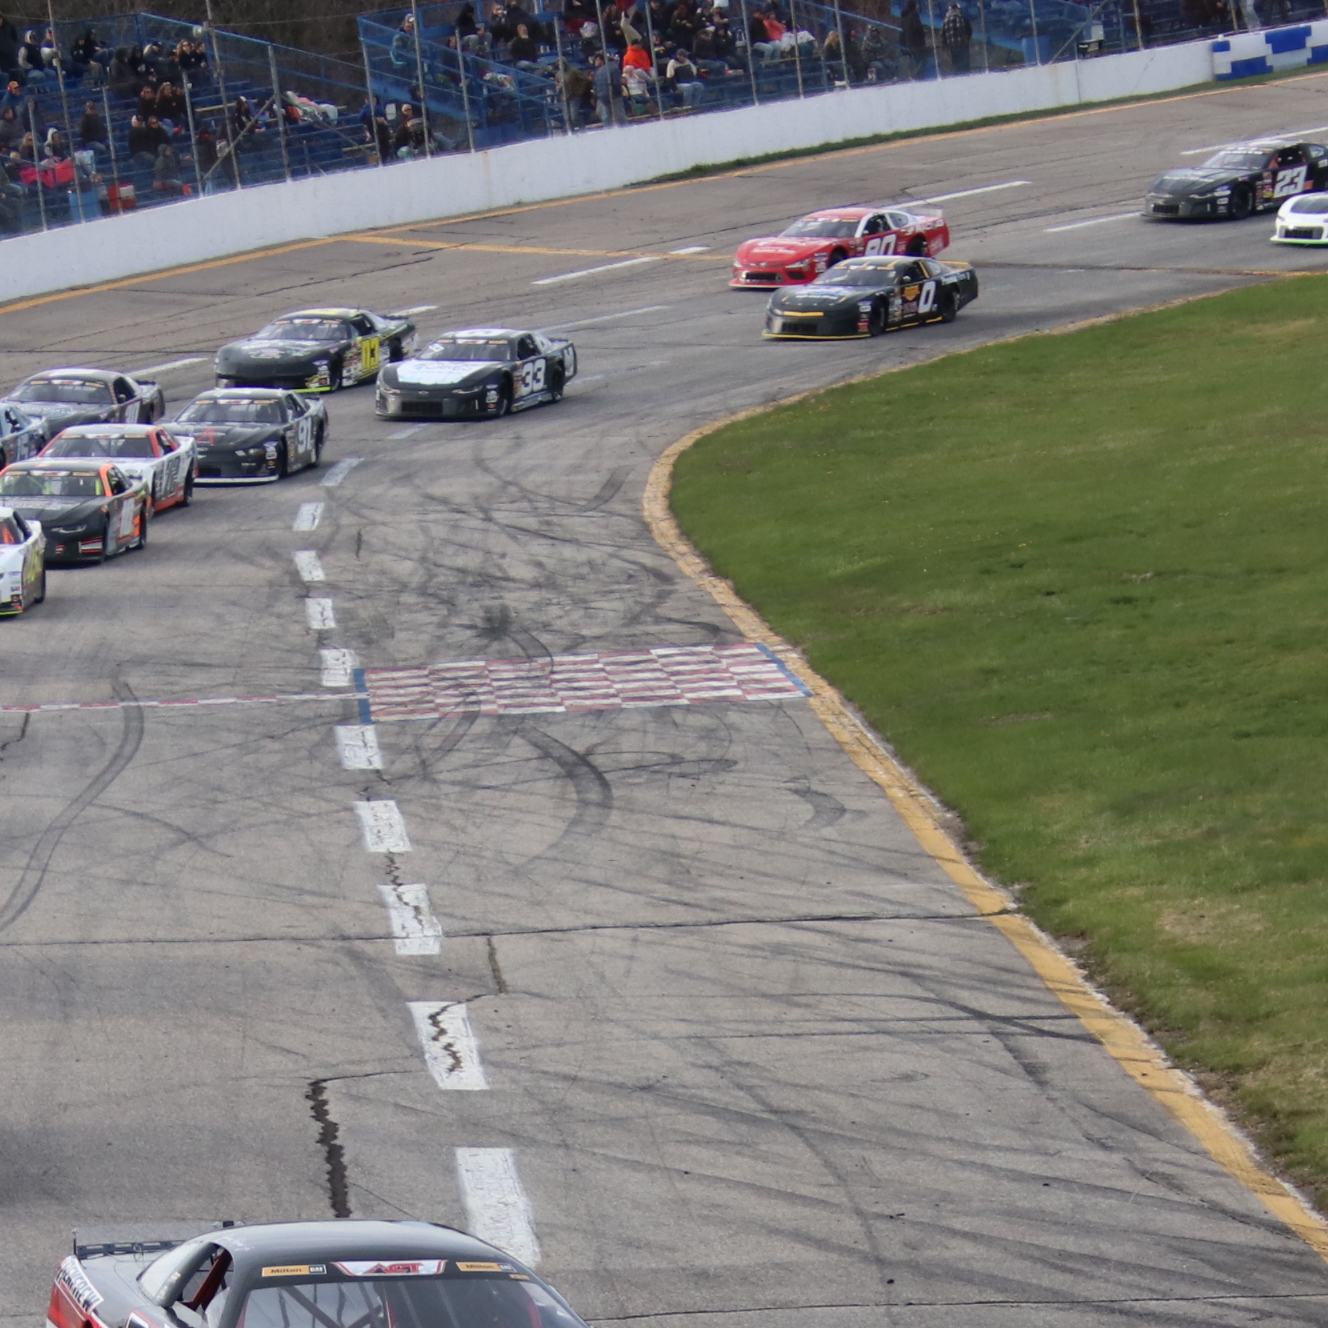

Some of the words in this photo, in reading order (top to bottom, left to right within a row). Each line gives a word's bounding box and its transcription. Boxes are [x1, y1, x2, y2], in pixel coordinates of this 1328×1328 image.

[1273, 165, 1308, 198] 23
[918, 281, 936, 313] 0
[522, 358, 546, 397] 33
[364, 1263, 421, 1274] ACT
